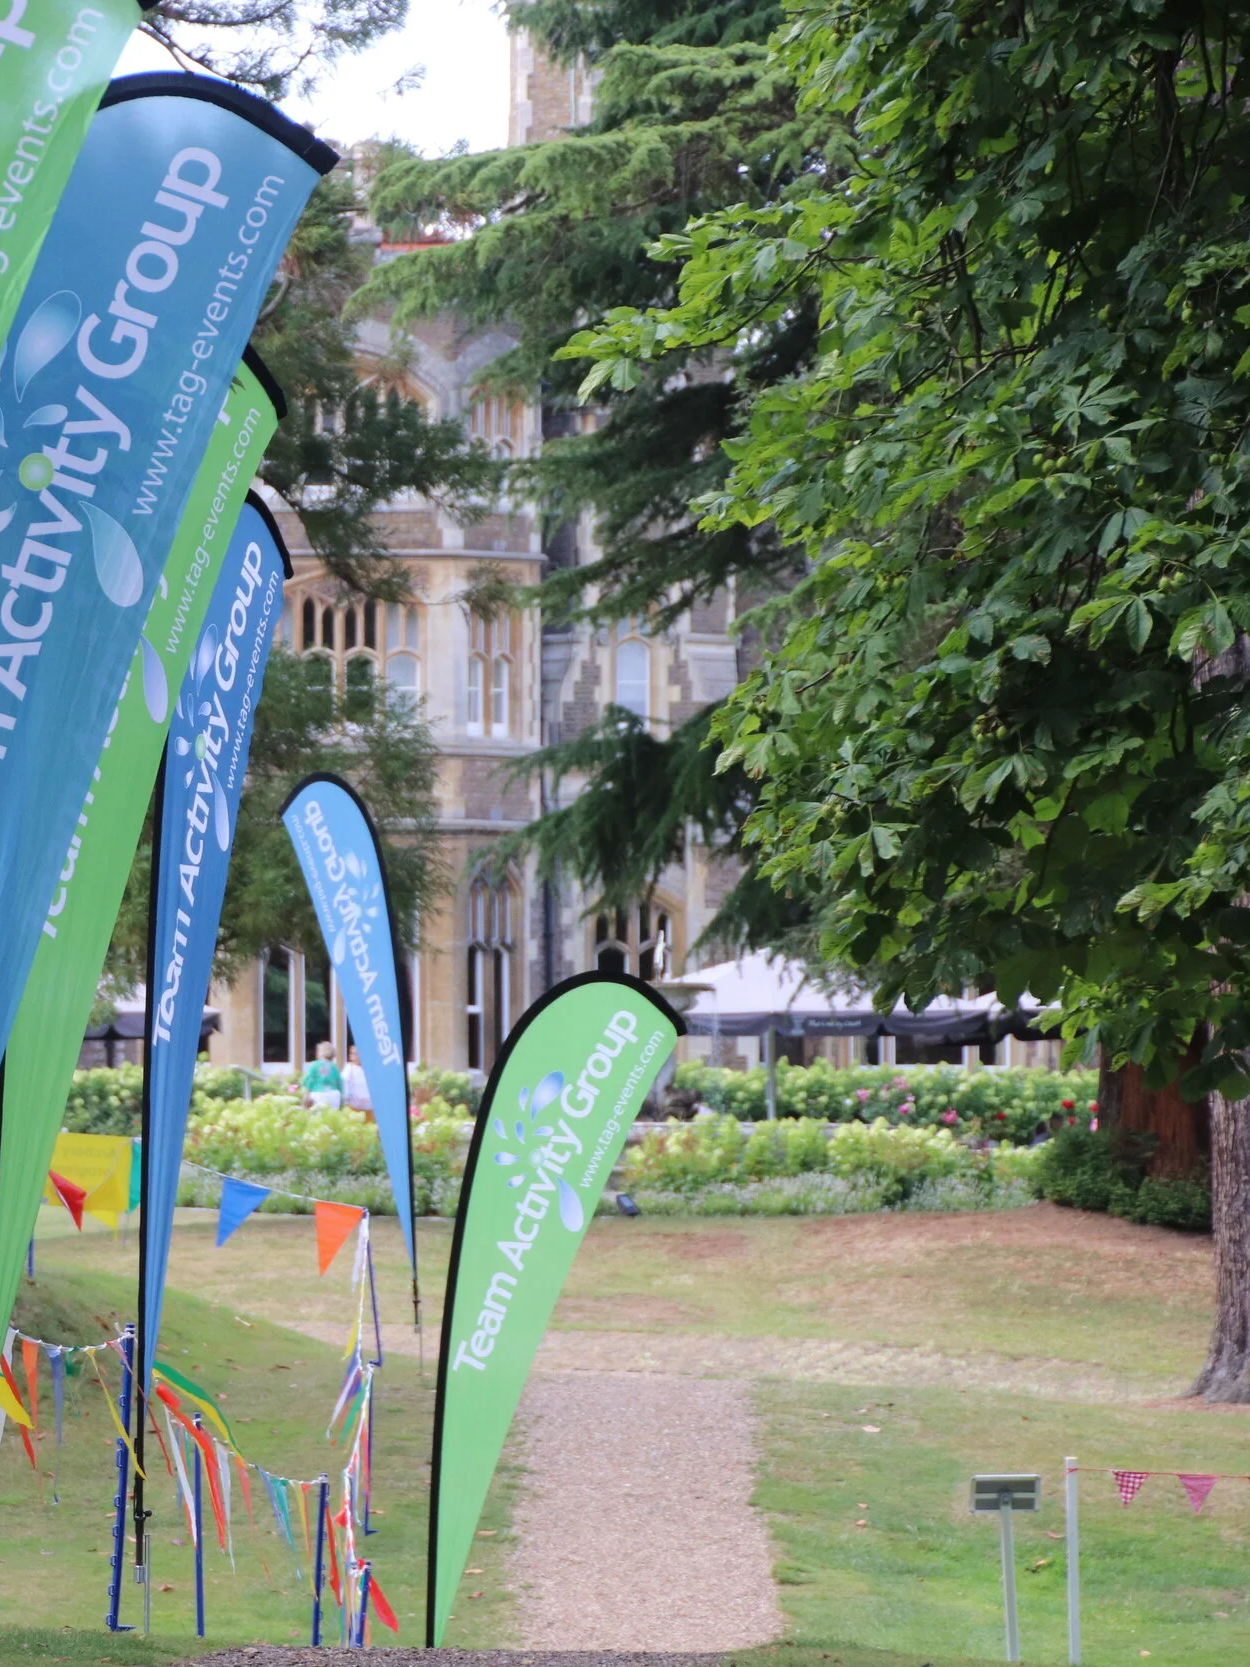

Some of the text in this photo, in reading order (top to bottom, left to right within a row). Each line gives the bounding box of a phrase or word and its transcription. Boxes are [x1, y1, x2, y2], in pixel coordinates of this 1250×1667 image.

[76, 146, 229, 379] Group
[132, 174, 286, 515] www.tag-events.com
[165, 406, 262, 655] www.tag-events.com
[179, 691, 229, 906] Activity
[215, 541, 262, 692] Group
[227, 570, 279, 789] www.tag-events.com
[452, 1009, 639, 1371] Team Activity Group
[580, 1030, 665, 1189] www.tag-events.com
